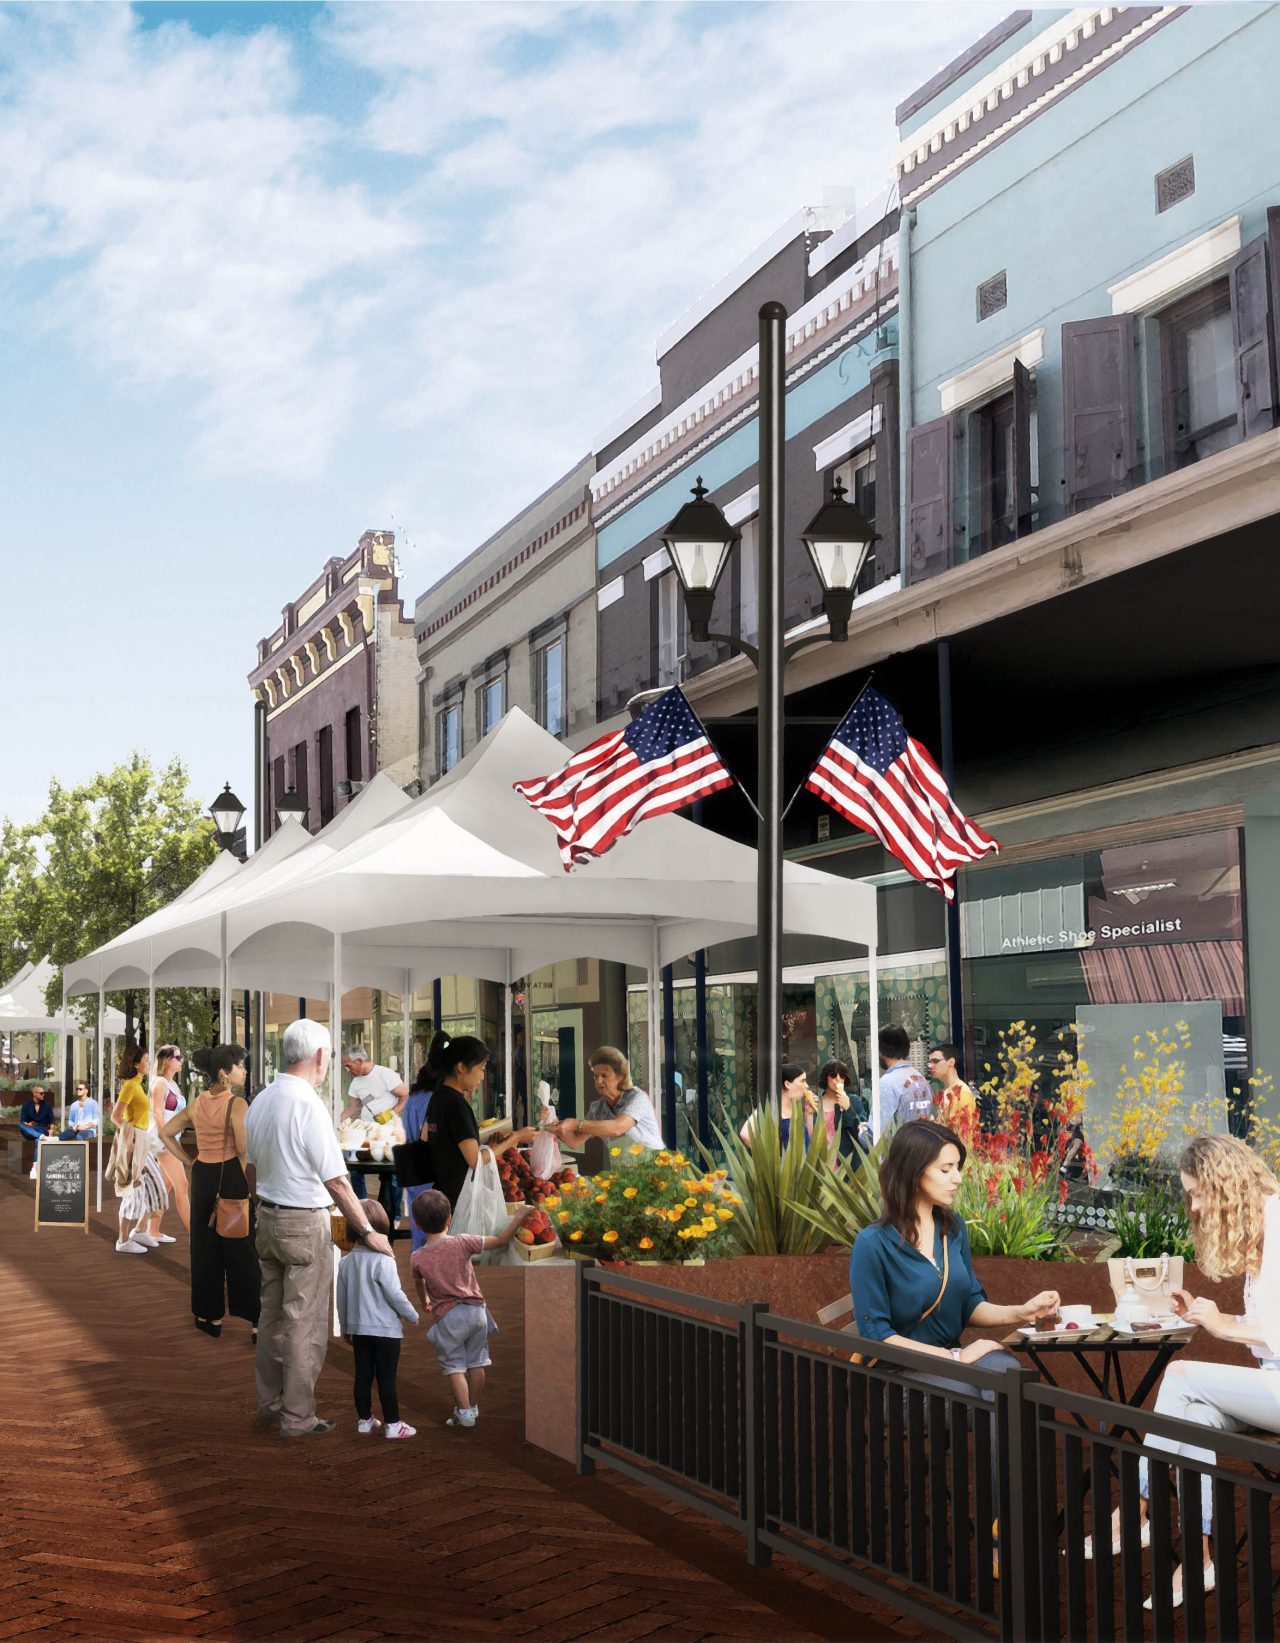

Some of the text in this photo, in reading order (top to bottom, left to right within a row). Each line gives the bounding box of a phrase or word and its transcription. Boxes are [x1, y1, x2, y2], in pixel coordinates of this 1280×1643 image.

[1002, 918, 1182, 949] Athletic Shoe Specialist
